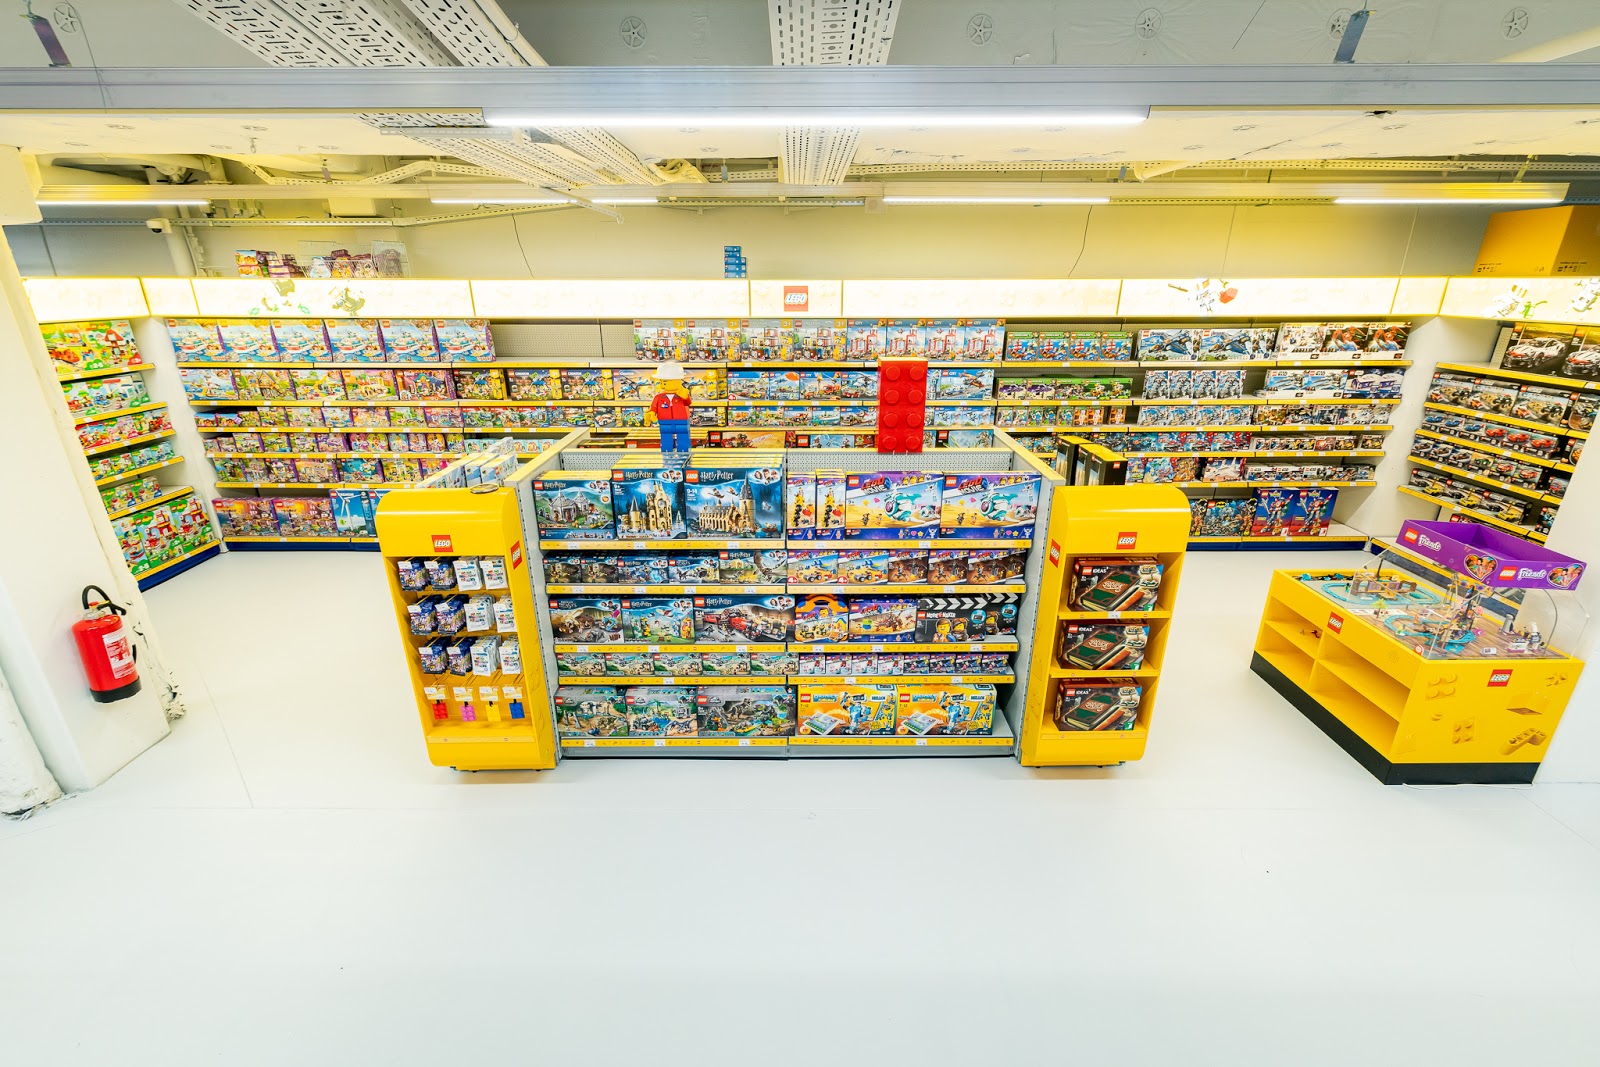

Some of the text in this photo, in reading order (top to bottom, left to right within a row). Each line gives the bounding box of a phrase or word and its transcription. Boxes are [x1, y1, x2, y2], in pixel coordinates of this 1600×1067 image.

[785, 293, 807, 304] LEGO
[700, 471, 717, 481] Harry
[716, 470, 734, 480] Potter
[861, 477, 885, 490] LEGO
[957, 477, 982, 490] LEGO
[434, 539, 451, 548] LEGO
[1417, 534, 1442, 551] Friends
[1050, 546, 1060, 559] LEGO
[1499, 568, 1547, 581] LEGO Friends
[1328, 616, 1342, 629] LEGO
[1490, 673, 1510, 683] LEGO
